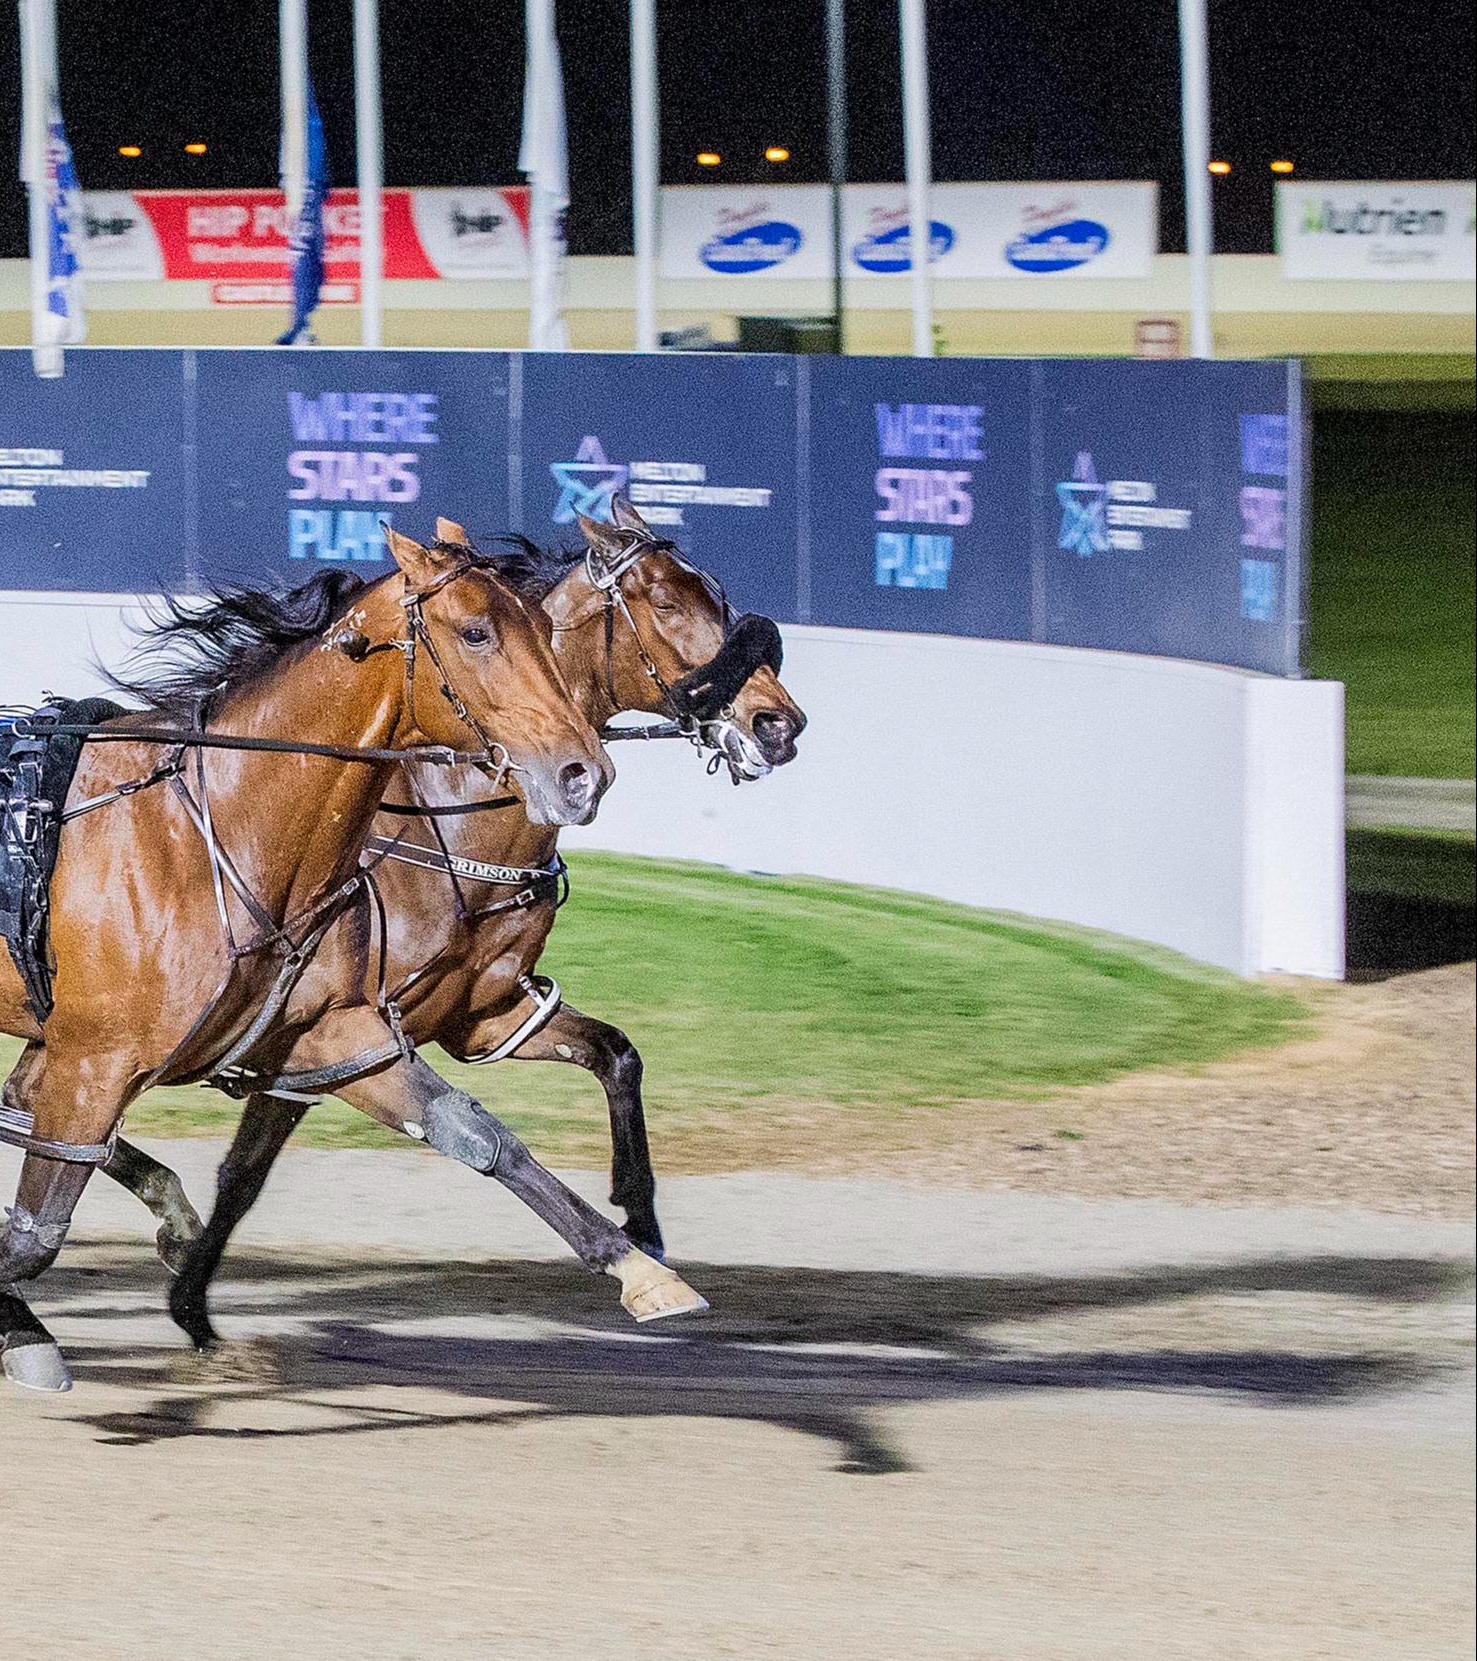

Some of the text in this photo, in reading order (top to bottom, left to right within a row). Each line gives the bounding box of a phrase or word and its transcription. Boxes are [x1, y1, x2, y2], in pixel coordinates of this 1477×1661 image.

[287, 391, 440, 443] WHERE
[287, 449, 420, 502] STARS
[288, 508, 392, 560] PLAY
